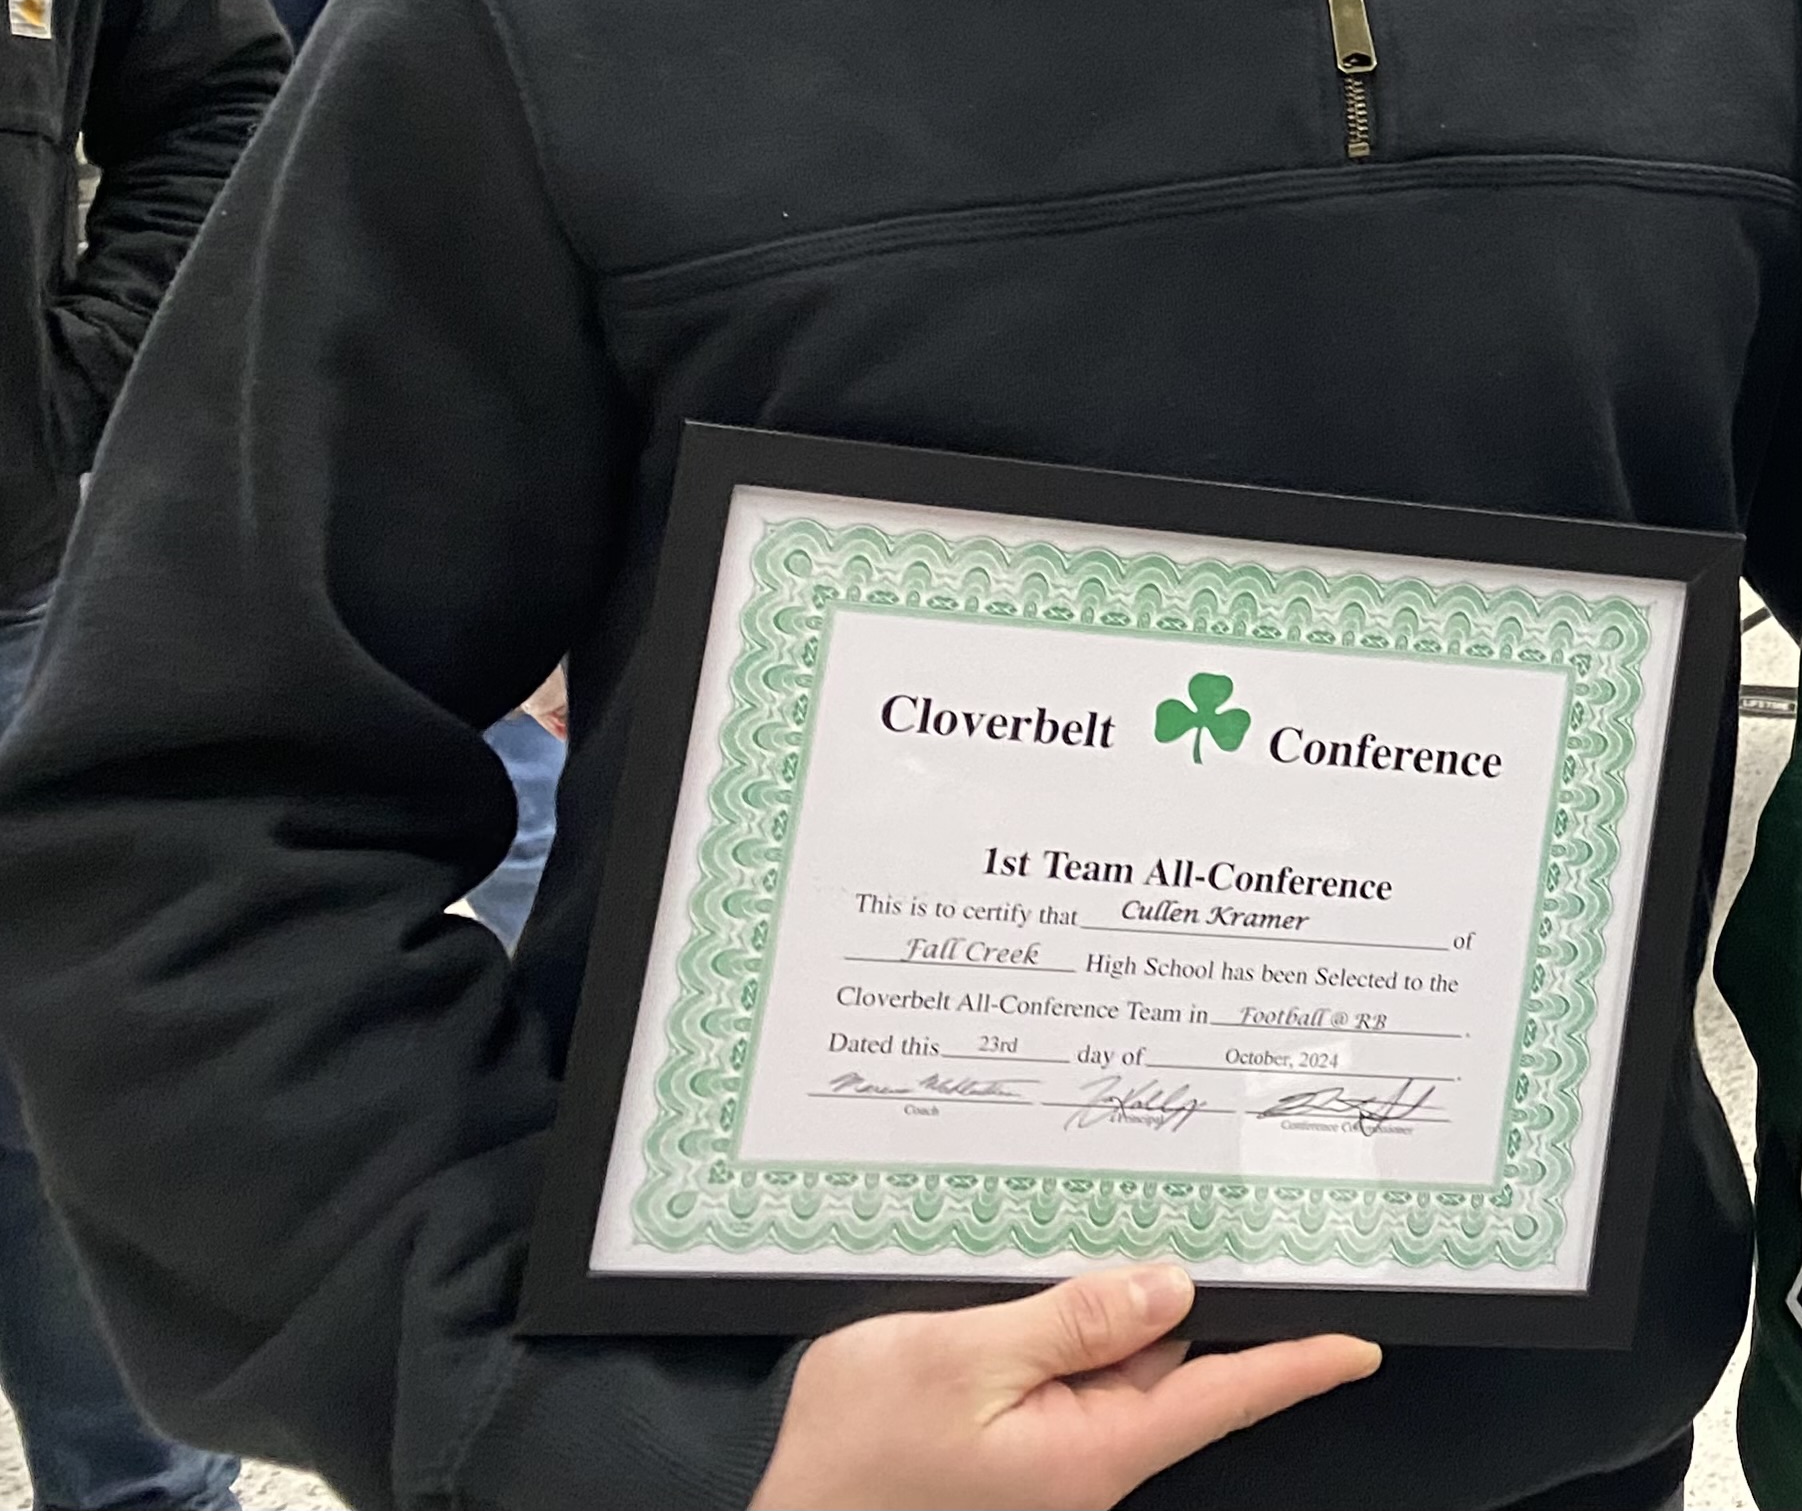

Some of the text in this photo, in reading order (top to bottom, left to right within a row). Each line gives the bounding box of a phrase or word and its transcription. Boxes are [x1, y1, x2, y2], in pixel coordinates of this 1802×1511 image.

[881, 694, 1502, 778] Cloverbelt Conference
[983, 847, 1393, 901] 1st Team All-Conference
[855, 892, 1477, 951] This is to certify that Cullen Kramer of
[906, 937, 1459, 993] Fall Creek High School has been Selected to the
[836, 985, 951, 1011] Cloverbelt
[956, 992, 1119, 1019] All-Conference
[1126, 1001, 1182, 1023] Team
[1188, 1006, 1208, 1025] in
[1238, 1006, 1330, 1029] Football
[1330, 1011, 1349, 1029] @
[828, 1031, 1340, 1070] Dated this 23rd day of October, 2024
